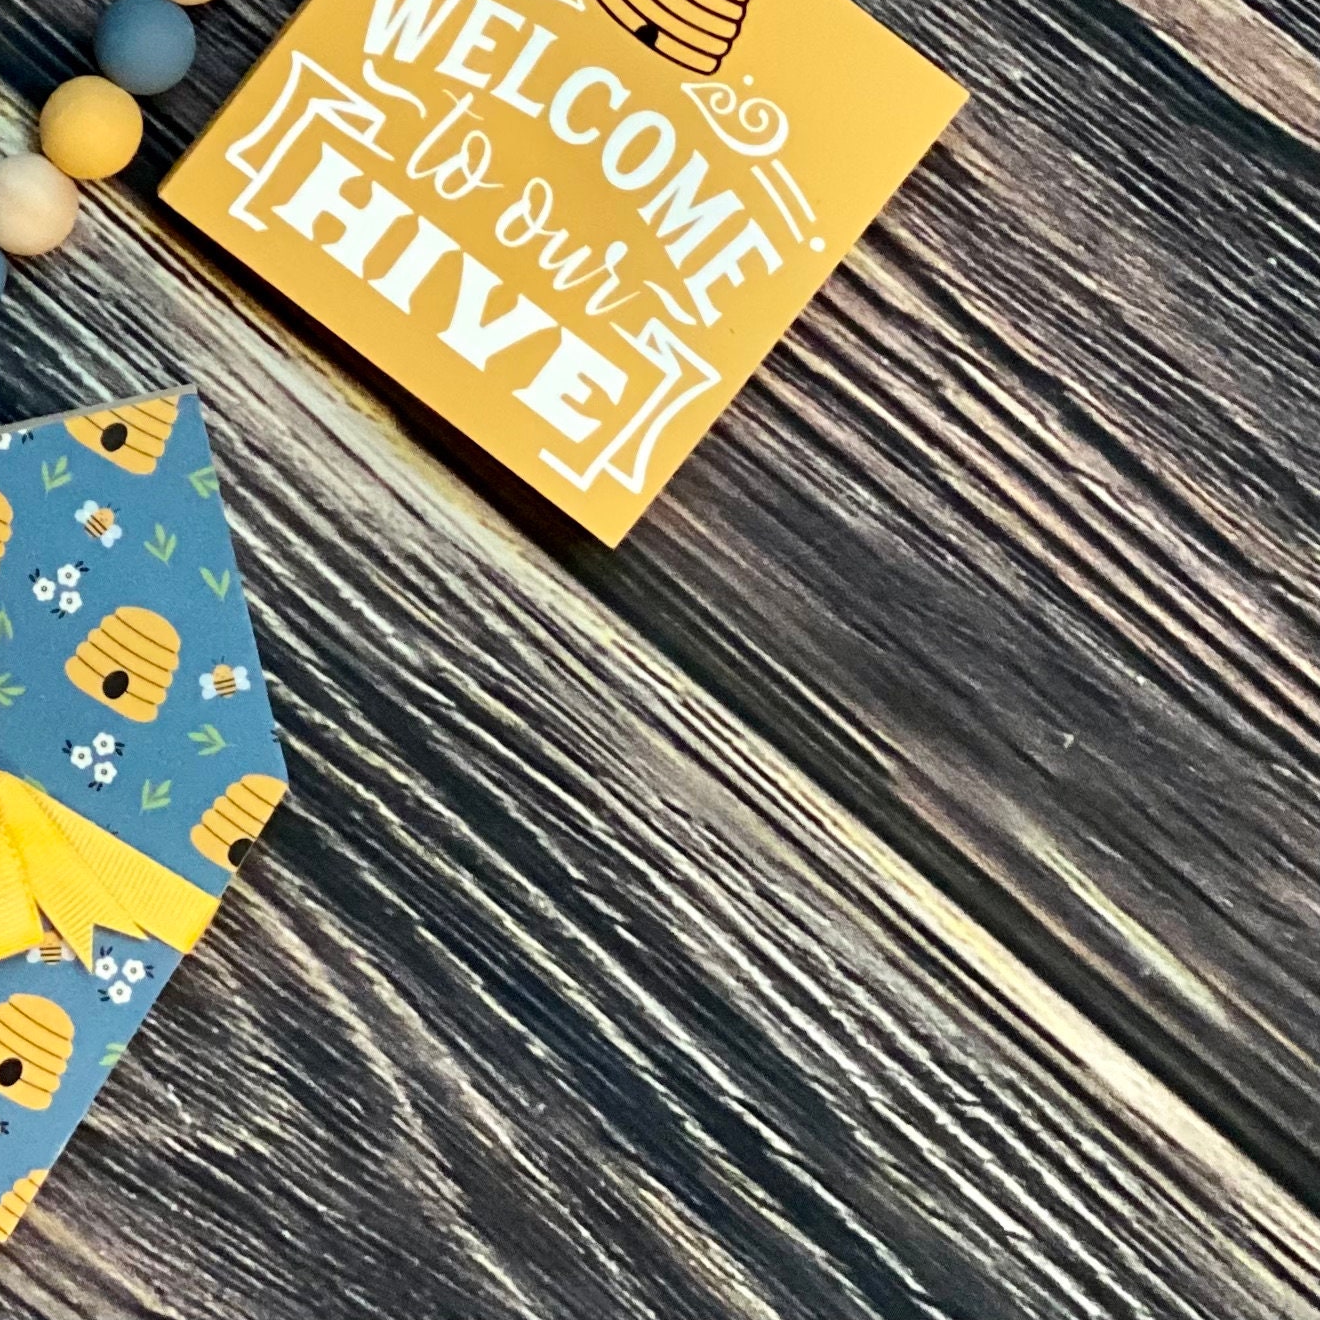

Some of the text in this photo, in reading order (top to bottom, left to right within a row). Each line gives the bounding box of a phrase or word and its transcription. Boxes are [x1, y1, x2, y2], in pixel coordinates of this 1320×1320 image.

[271, 142, 629, 443] HIVE
[406, 89, 641, 317] to our
